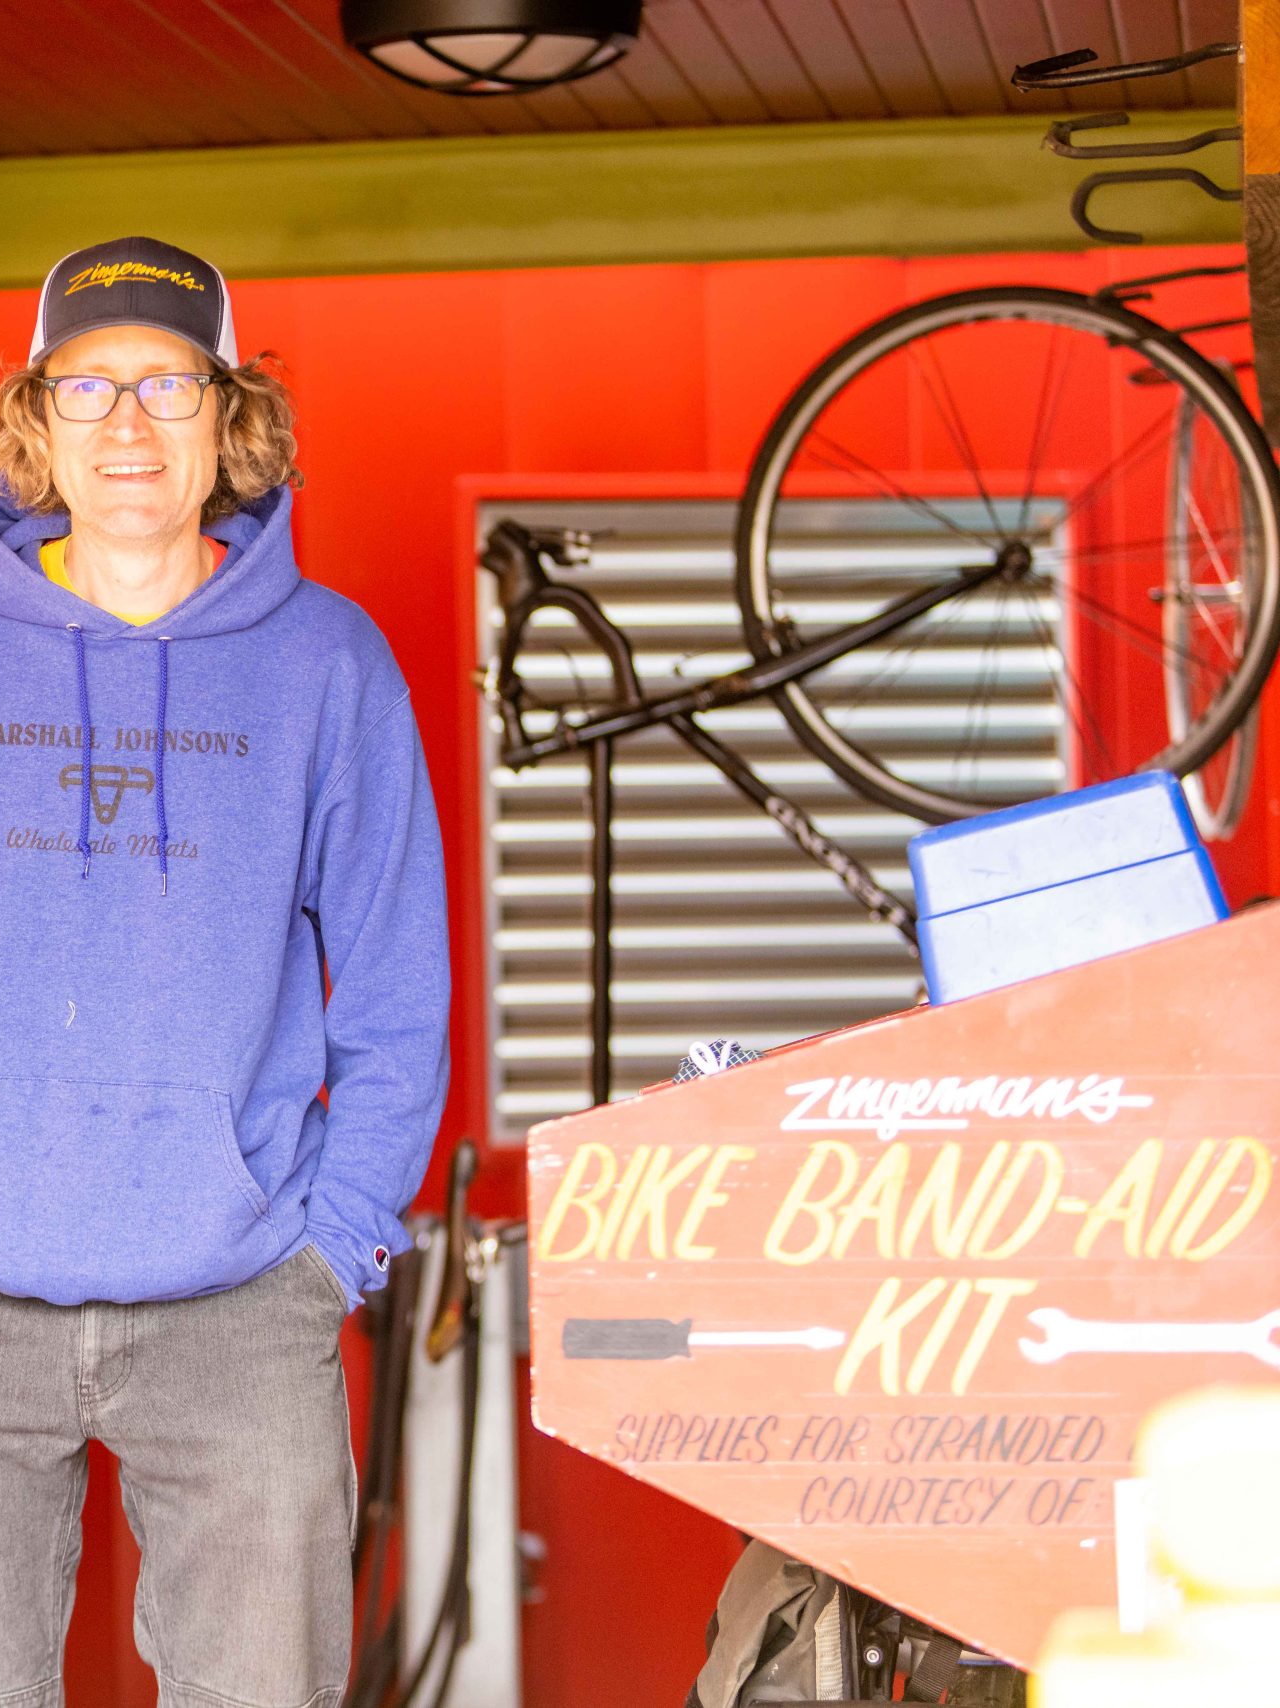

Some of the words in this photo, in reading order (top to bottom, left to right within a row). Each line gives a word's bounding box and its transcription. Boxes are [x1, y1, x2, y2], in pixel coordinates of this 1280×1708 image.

[114, 727, 249, 757] JOHNSON'S
[780, 1074, 1154, 1141] Zingerman's
[537, 1141, 757, 1264] BIKE
[762, 1136, 1276, 1267] BAND-AID
[833, 1275, 1039, 1398] KIT
[612, 1413, 778, 1463] SUPPLIES
[790, 1414, 870, 1463] FOR
[884, 1414, 1105, 1466] STRANDED
[800, 1475, 1017, 1527] COURTESY
